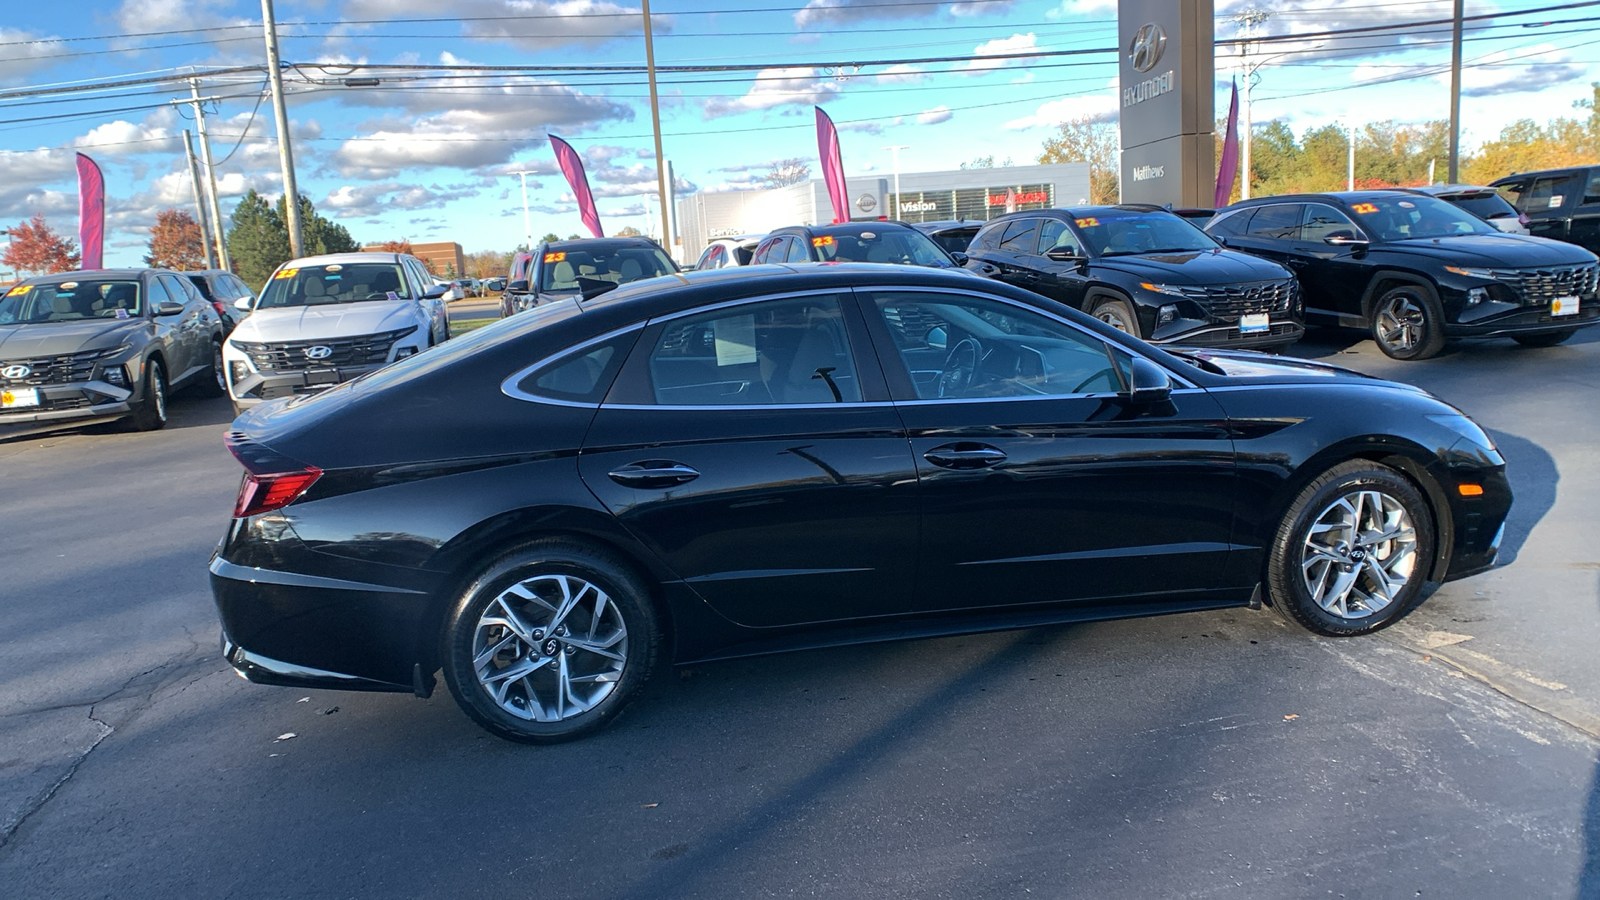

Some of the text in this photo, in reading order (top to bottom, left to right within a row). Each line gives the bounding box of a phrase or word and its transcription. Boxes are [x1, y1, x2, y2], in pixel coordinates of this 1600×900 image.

[1123, 70, 1174, 108] HYUNDAI
[1133, 165, 1165, 182] Matthews
[988, 191, 1047, 205] NISAN
[901, 202, 936, 212] Vision
[1351, 203, 1380, 214] 22
[1075, 217, 1100, 228] 22
[812, 236, 833, 247] 23
[545, 252, 566, 263] 23
